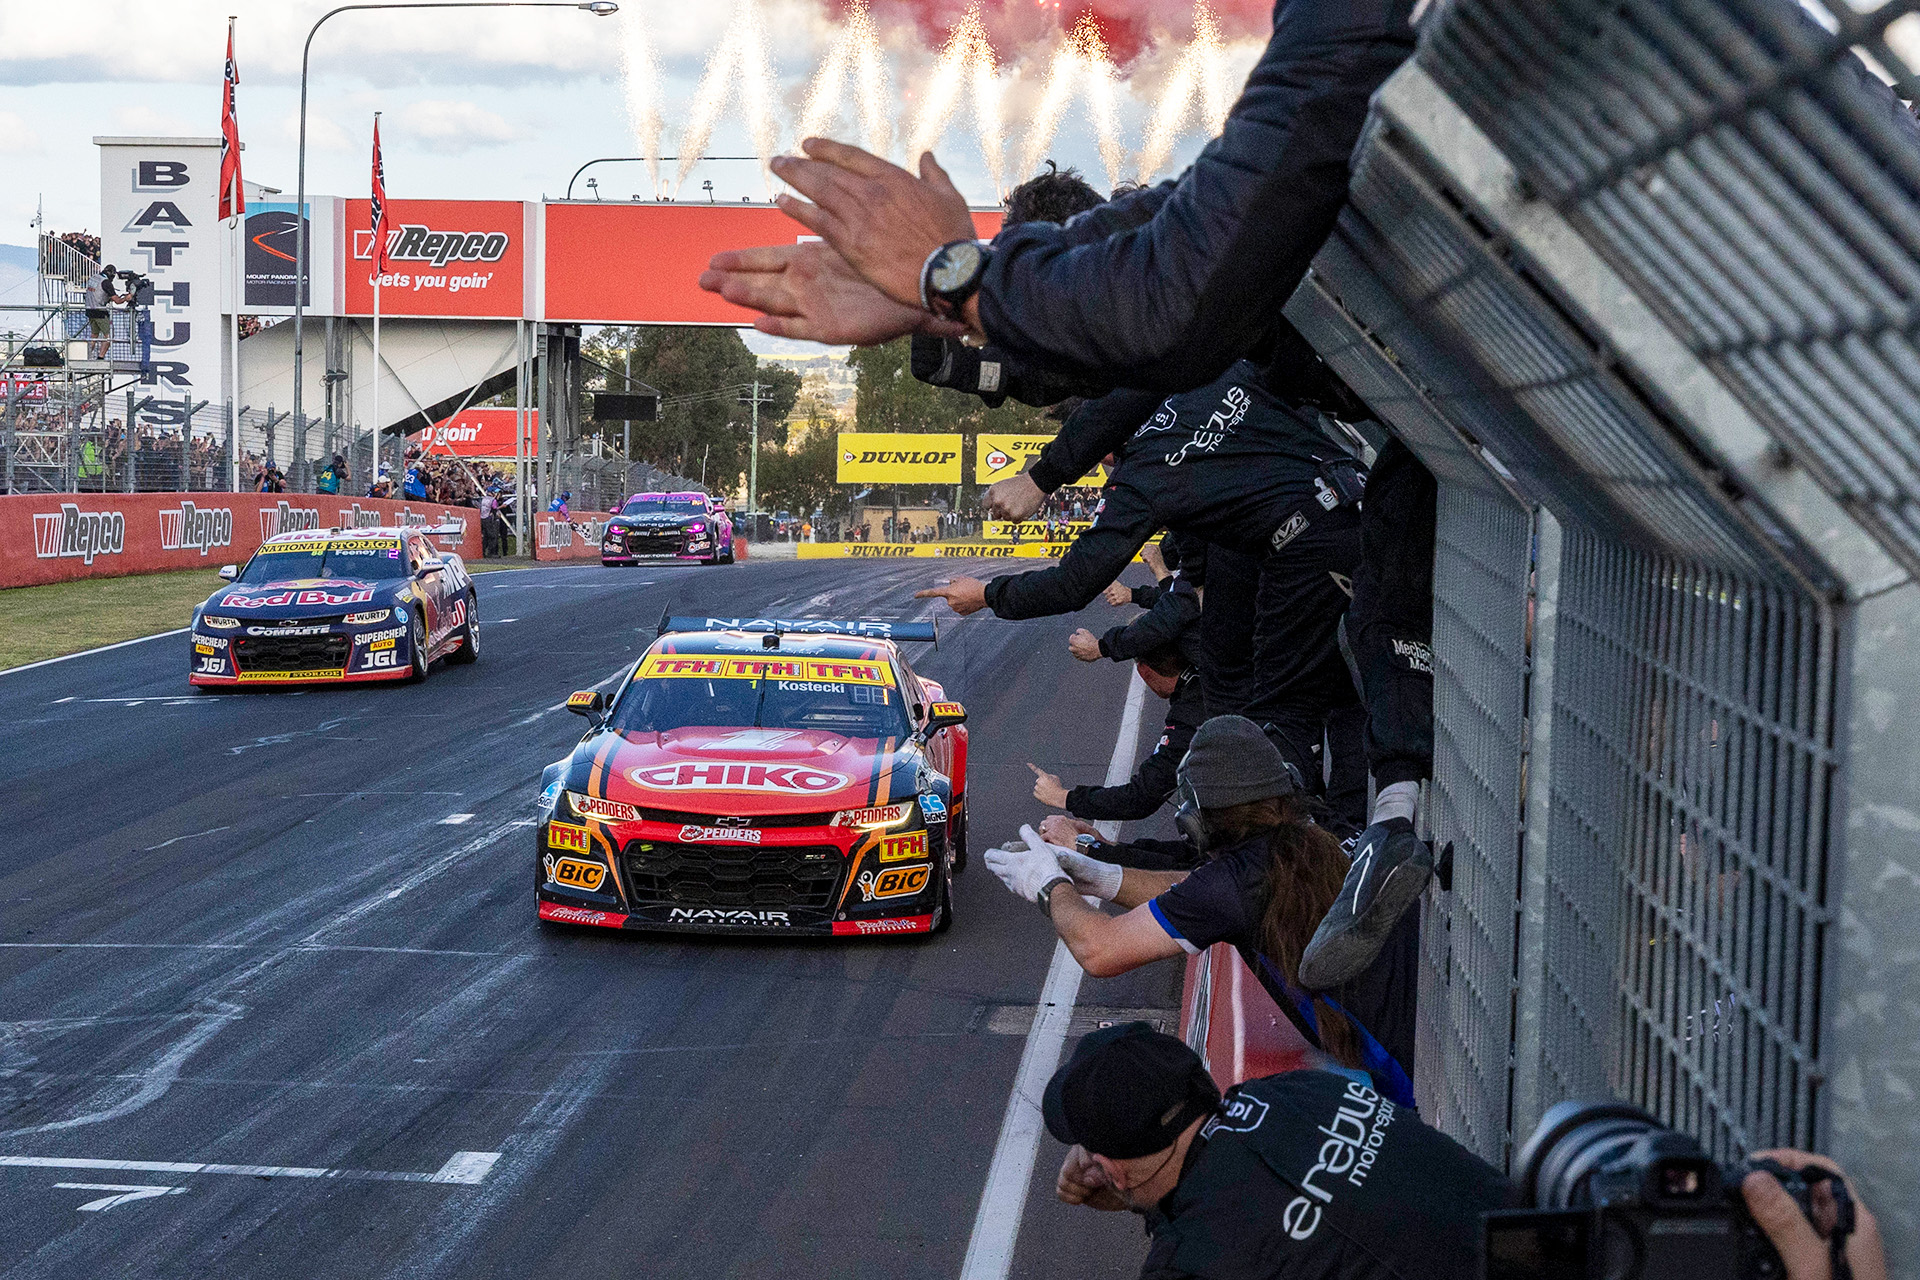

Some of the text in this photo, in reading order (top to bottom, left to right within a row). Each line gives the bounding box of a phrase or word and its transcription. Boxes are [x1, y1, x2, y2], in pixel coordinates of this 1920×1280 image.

[389, 224, 510, 267] Repco
[413, 275, 446, 291] you
[1011, 441, 1046, 450] STIC
[859, 451, 956, 464] DUNLOP
[59, 503, 125, 565] Repco
[180, 501, 232, 556] Repco
[261, 540, 394, 553] NATIONAL STORAGE
[851, 546, 914, 556] DUNLOP
[944, 547, 1014, 557] DUNLOP
[220, 589, 375, 608] Red Bull
[355, 626, 407, 645] SUPERCHEAP
[373, 641, 393, 649] AUTO
[197, 657, 226, 673] JGI
[361, 650, 397, 668] JGI
[655, 660, 714, 673] TFH
[732, 662, 793, 675] TFH
[810, 664, 873, 680] TFH
[749, 680, 844, 693] 1 Kostecki
[571, 693, 591, 702] TFH
[935, 704, 958, 713] TFH
[638, 765, 841, 790] CHIKO
[590, 799, 634, 820] PEDDERS
[854, 806, 901, 824] PEDDERS
[924, 812, 947, 823] SIGNS
[550, 825, 583, 847] TFH
[704, 827, 762, 841] PEDDERS
[884, 835, 923, 856] TFH
[708, 919, 791, 927] SERVICES
[1348, 1096, 1396, 1187] motorsport
[1283, 1082, 1379, 1241] erebus
